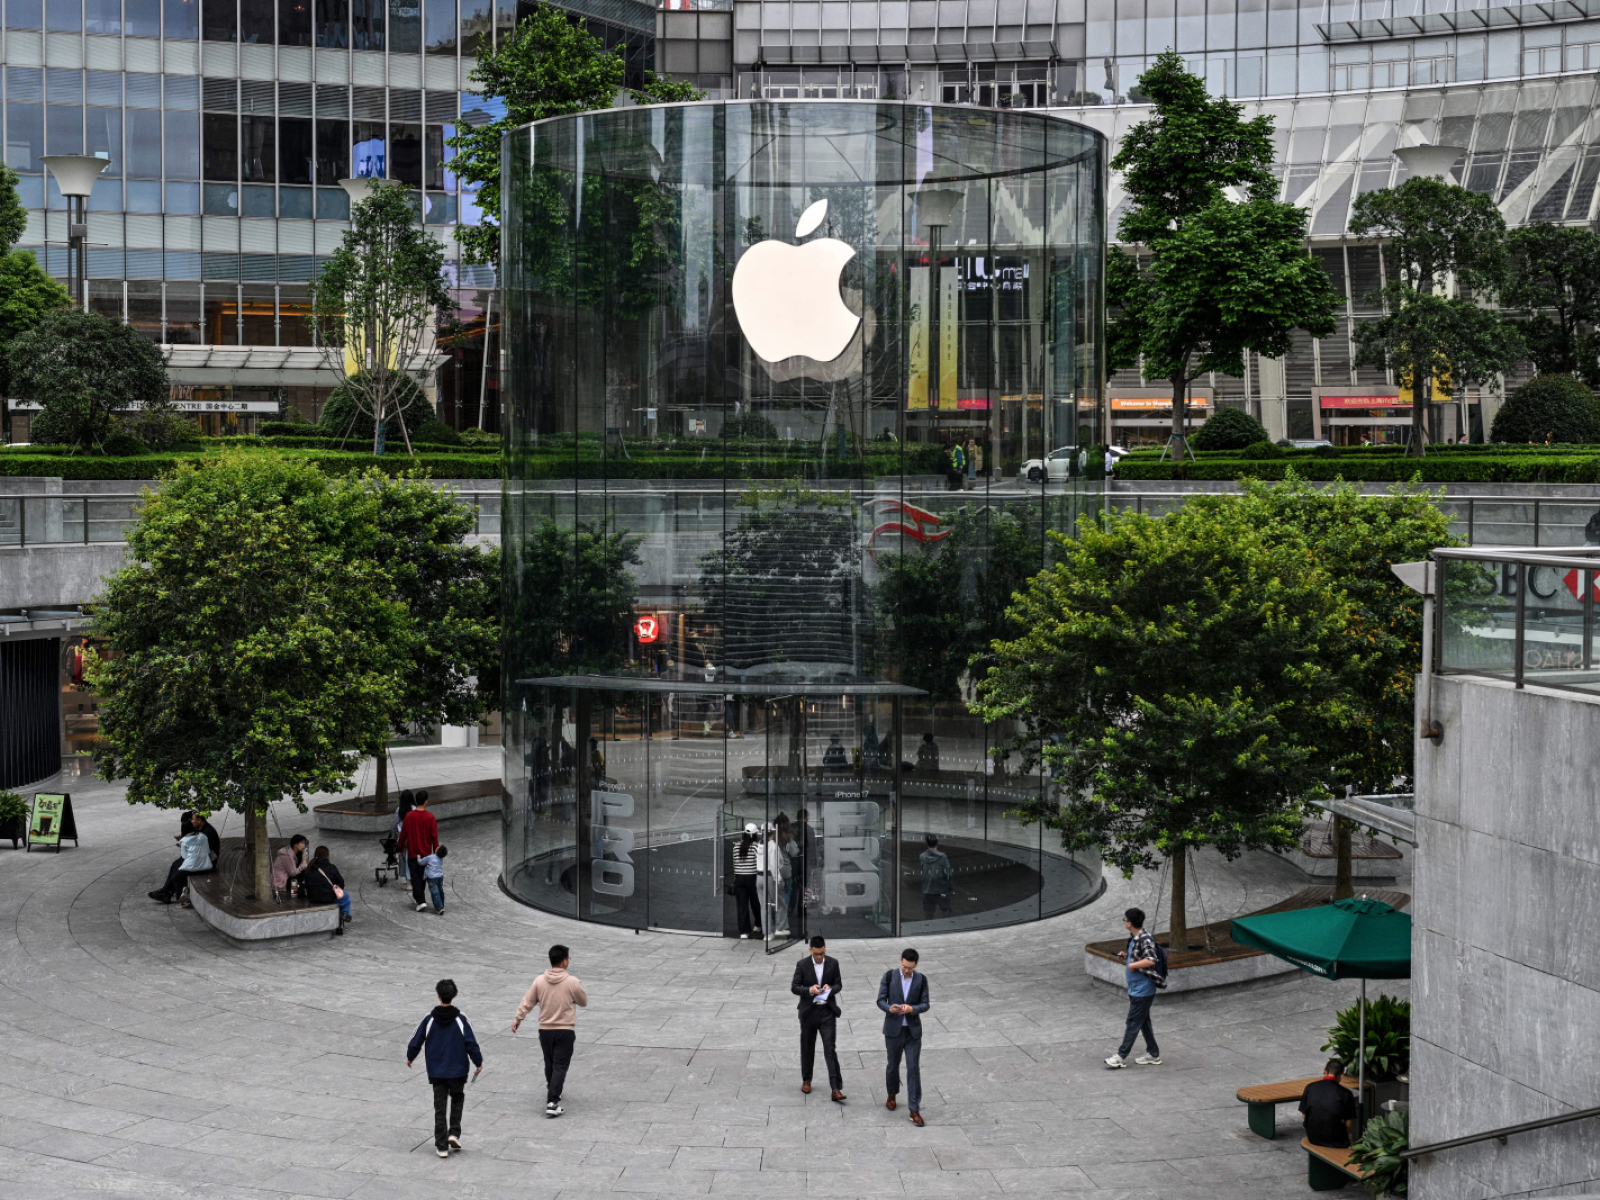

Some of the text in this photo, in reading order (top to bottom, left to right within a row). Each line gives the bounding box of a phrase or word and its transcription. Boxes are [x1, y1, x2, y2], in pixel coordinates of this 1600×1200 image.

[590, 789, 635, 897] PRO
[861, 790, 869, 798] 17
[823, 801, 880, 907] PRO
